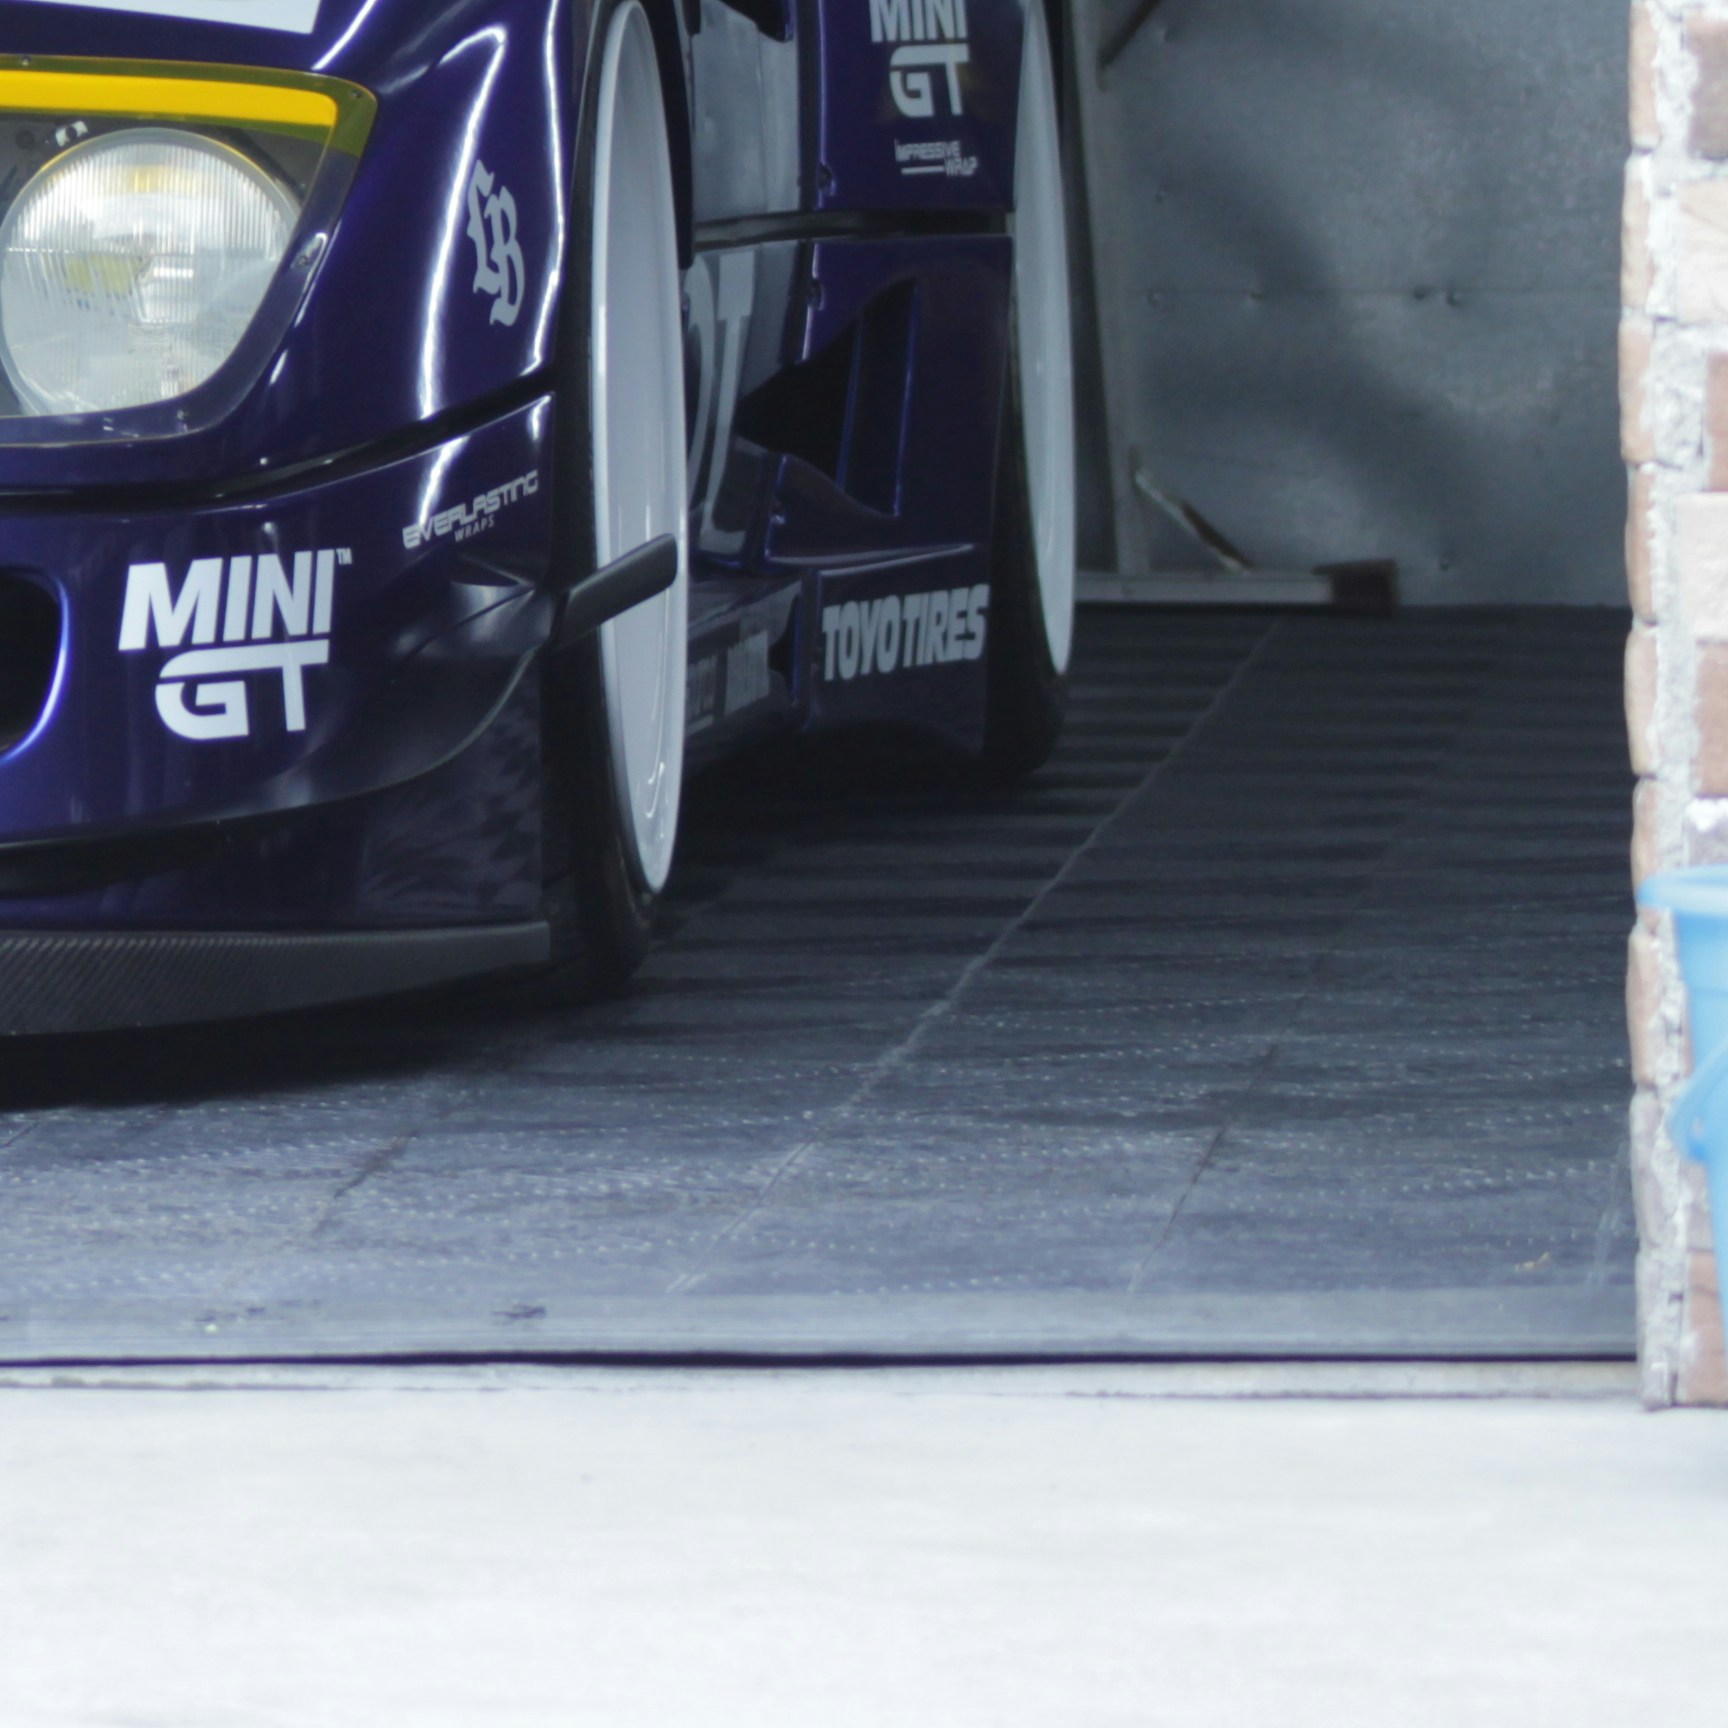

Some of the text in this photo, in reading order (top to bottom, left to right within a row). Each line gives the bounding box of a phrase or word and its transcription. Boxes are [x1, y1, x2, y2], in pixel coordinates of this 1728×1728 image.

[889, 43, 969, 118] GT
[118, 549, 335, 652] MINI
[822, 594, 904, 682] TOYO
[901, 583, 990, 668] TIRES
[155, 639, 330, 740] GT
